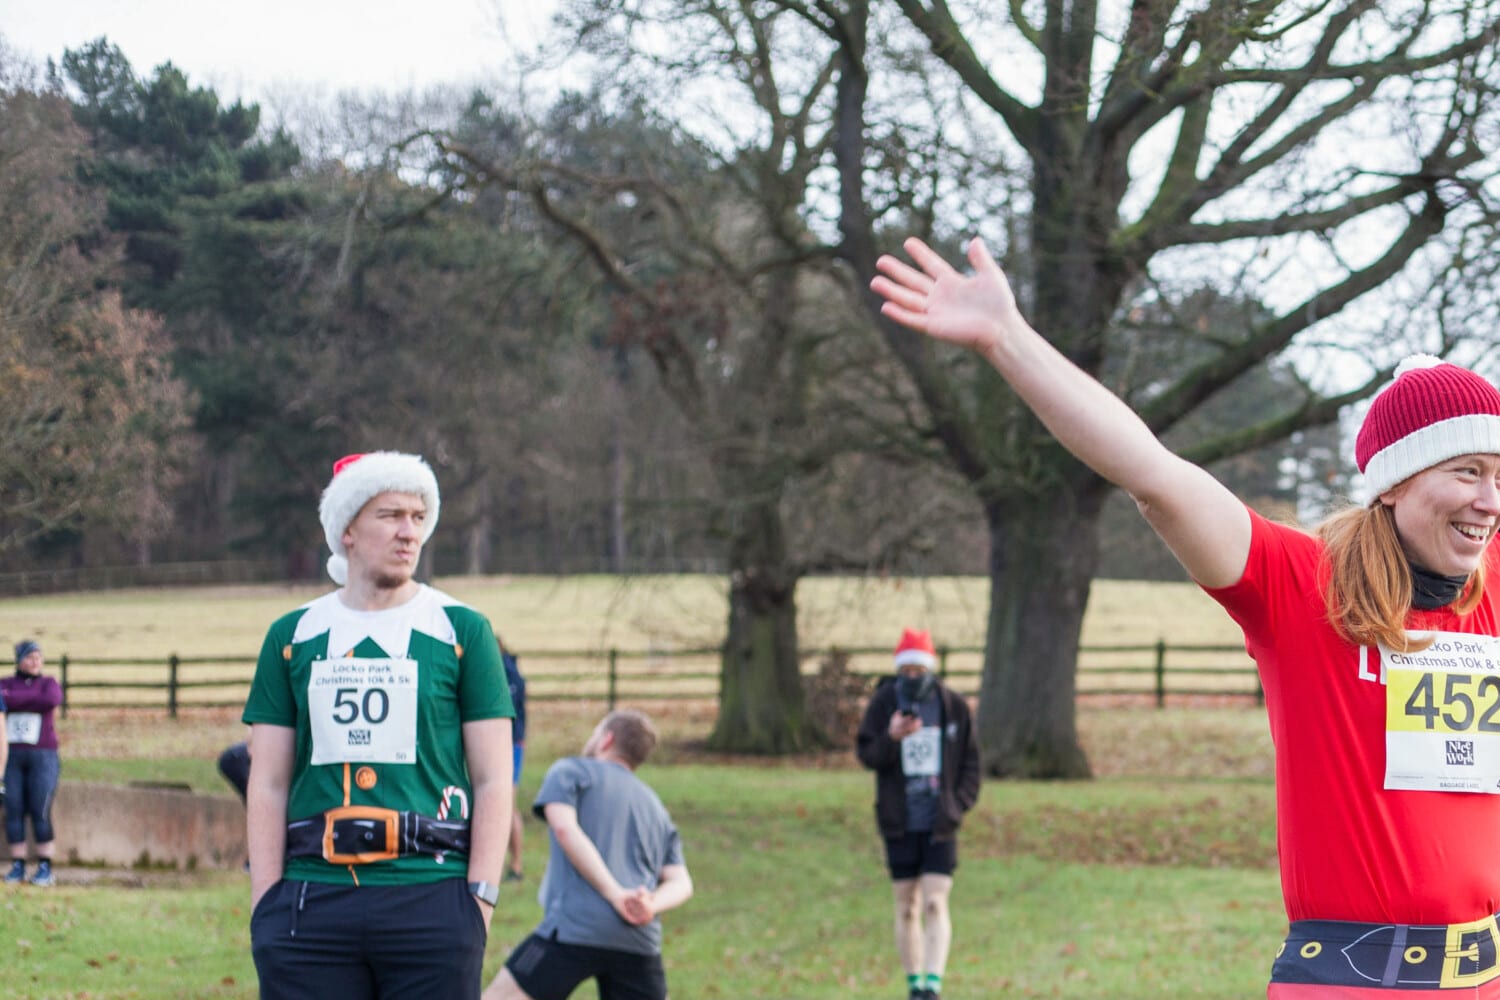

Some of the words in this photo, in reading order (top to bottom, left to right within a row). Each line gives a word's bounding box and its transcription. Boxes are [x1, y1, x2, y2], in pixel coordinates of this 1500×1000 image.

[1454, 641, 1485, 654] Park
[333, 664, 365, 673] Locko
[368, 664, 392, 673] Park
[1390, 654, 1458, 668] Christmas
[1459, 657, 1483, 669] 10k
[1486, 660, 1494, 670] &
[315, 675, 364, 686] Christmas
[332, 688, 390, 725] 50
[1448, 741, 1471, 753] Nice
[1446, 750, 1473, 765] Work
